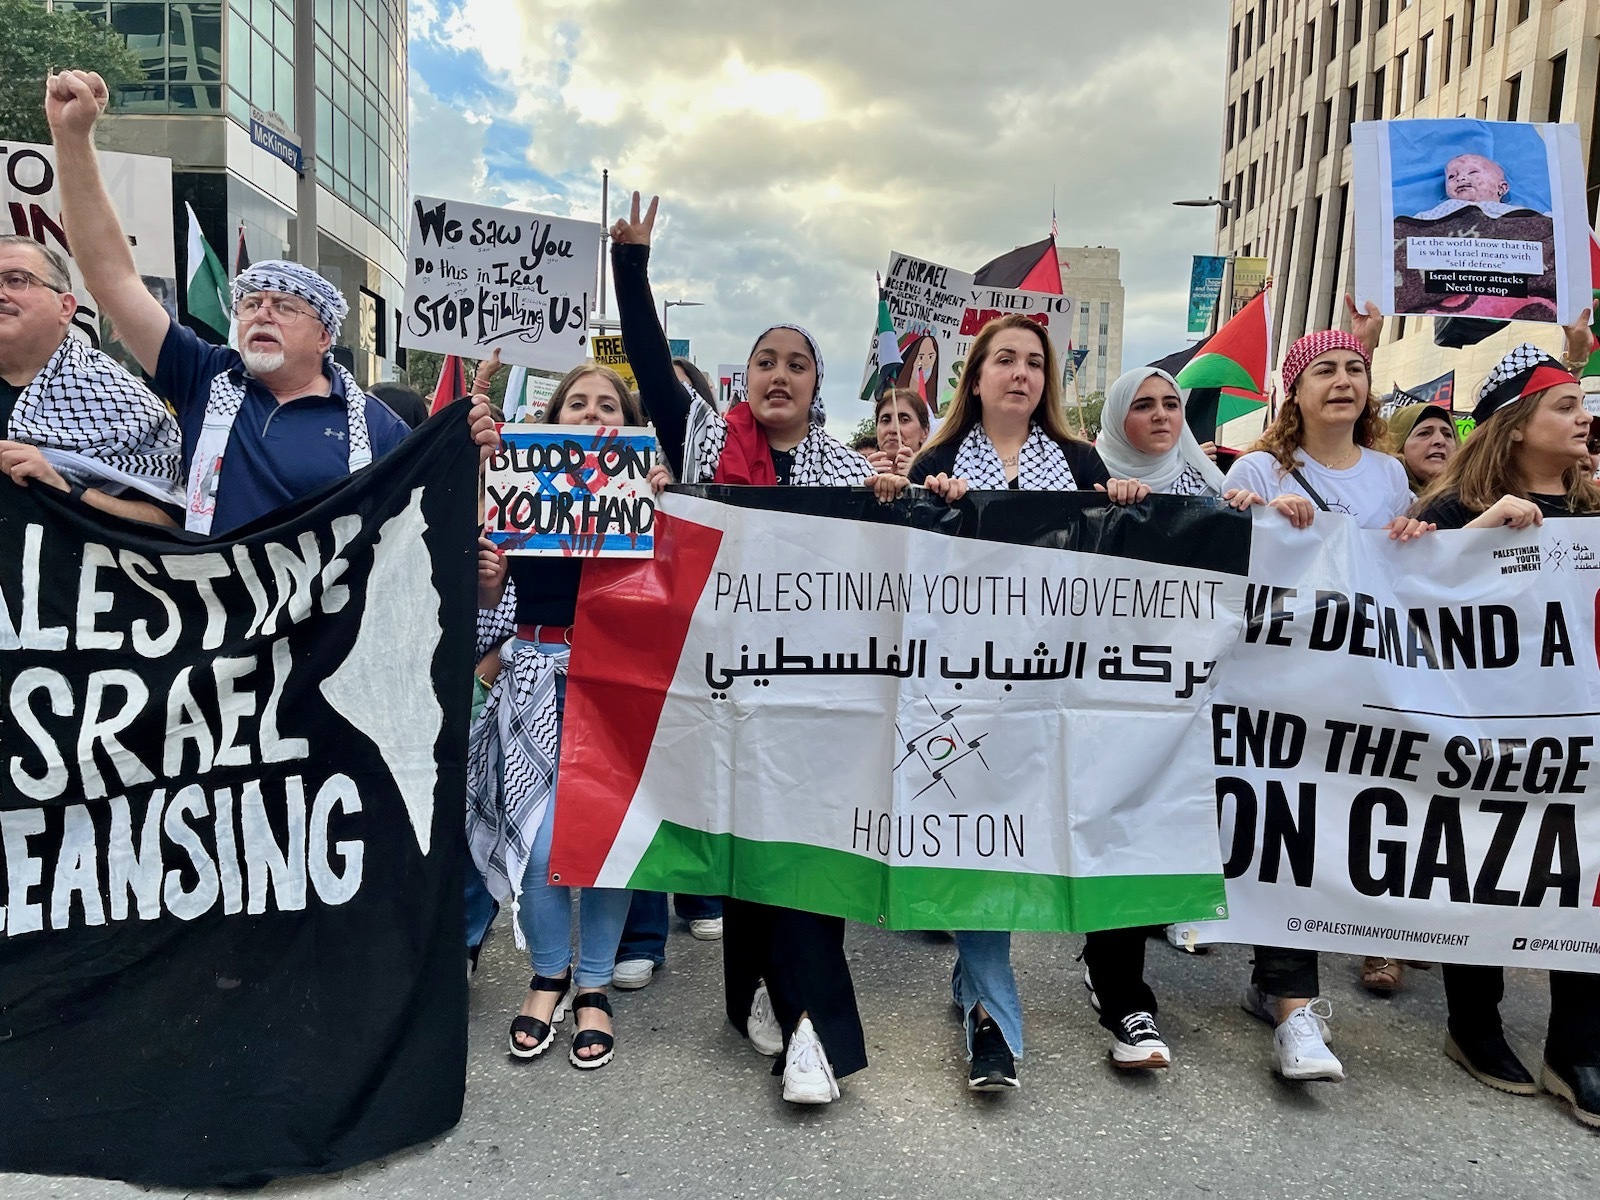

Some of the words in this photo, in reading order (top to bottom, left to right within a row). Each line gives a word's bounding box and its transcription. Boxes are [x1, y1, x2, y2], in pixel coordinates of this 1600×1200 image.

[253, 110, 264, 123] 600
[254, 123, 298, 167] McKinney
[1419, 248, 1426, 256] is
[1429, 249, 1451, 257] what
[1454, 249, 1479, 257] Israel
[1481, 252, 1509, 260] means
[1511, 252, 1531, 261] with
[1446, 239, 1472, 247] world
[1474, 240, 1499, 248] know
[1501, 241, 1519, 250] that
[1522, 242, 1539, 251] this
[885, 277, 921, 295] DESERVES
[924, 288, 931, 298] A
[892, 257, 908, 276] IF
[907, 260, 948, 290] ISRAEL
[1429, 272, 1456, 281] Israel
[1458, 273, 1487, 282] terror
[1489, 274, 1524, 285] attacks
[1445, 283, 1472, 292] Need
[1474, 284, 1485, 293] to
[1487, 285, 1509, 296] stop
[407, 293, 475, 339] STOP
[889, 296, 933, 323] PALESTINE
[933, 313, 960, 327] DESERVES
[986, 291, 1034, 310] TRIED
[1041, 297, 1071, 314] TO
[489, 439, 585, 473] BLOOD
[598, 439, 650, 479] ON
[487, 485, 575, 535] YOUR
[581, 495, 655, 535] HAND
[1493, 545, 1540, 559] PALESTINIAN
[1501, 562, 1541, 575] MOVEMENT
[1516, 554, 1541, 564] YOUTH
[715, 572, 911, 614] PALESTINIAN
[922, 575, 1027, 617] YOUTH
[1041, 577, 1223, 620] MOVEMENT
[1308, 589, 1519, 671] DEMAND
[1540, 601, 1575, 667] A
[705, 637, 926, 700] الفلسطيني
[940, 641, 1086, 691] الشباب
[9, 637, 309, 800] SRAEL
[1211, 704, 1307, 769] END
[1323, 719, 1429, 782] THE
[1437, 735, 1594, 794] SIEGE
[852, 807, 1025, 858] HOUSTON
[1215, 777, 1317, 888] ON
[1348, 787, 1581, 909] GAZA
[0, 773, 364, 936] EANSING
[1304, 919, 1470, 947] @PALESTINIANYOUTHMOVEMENT
